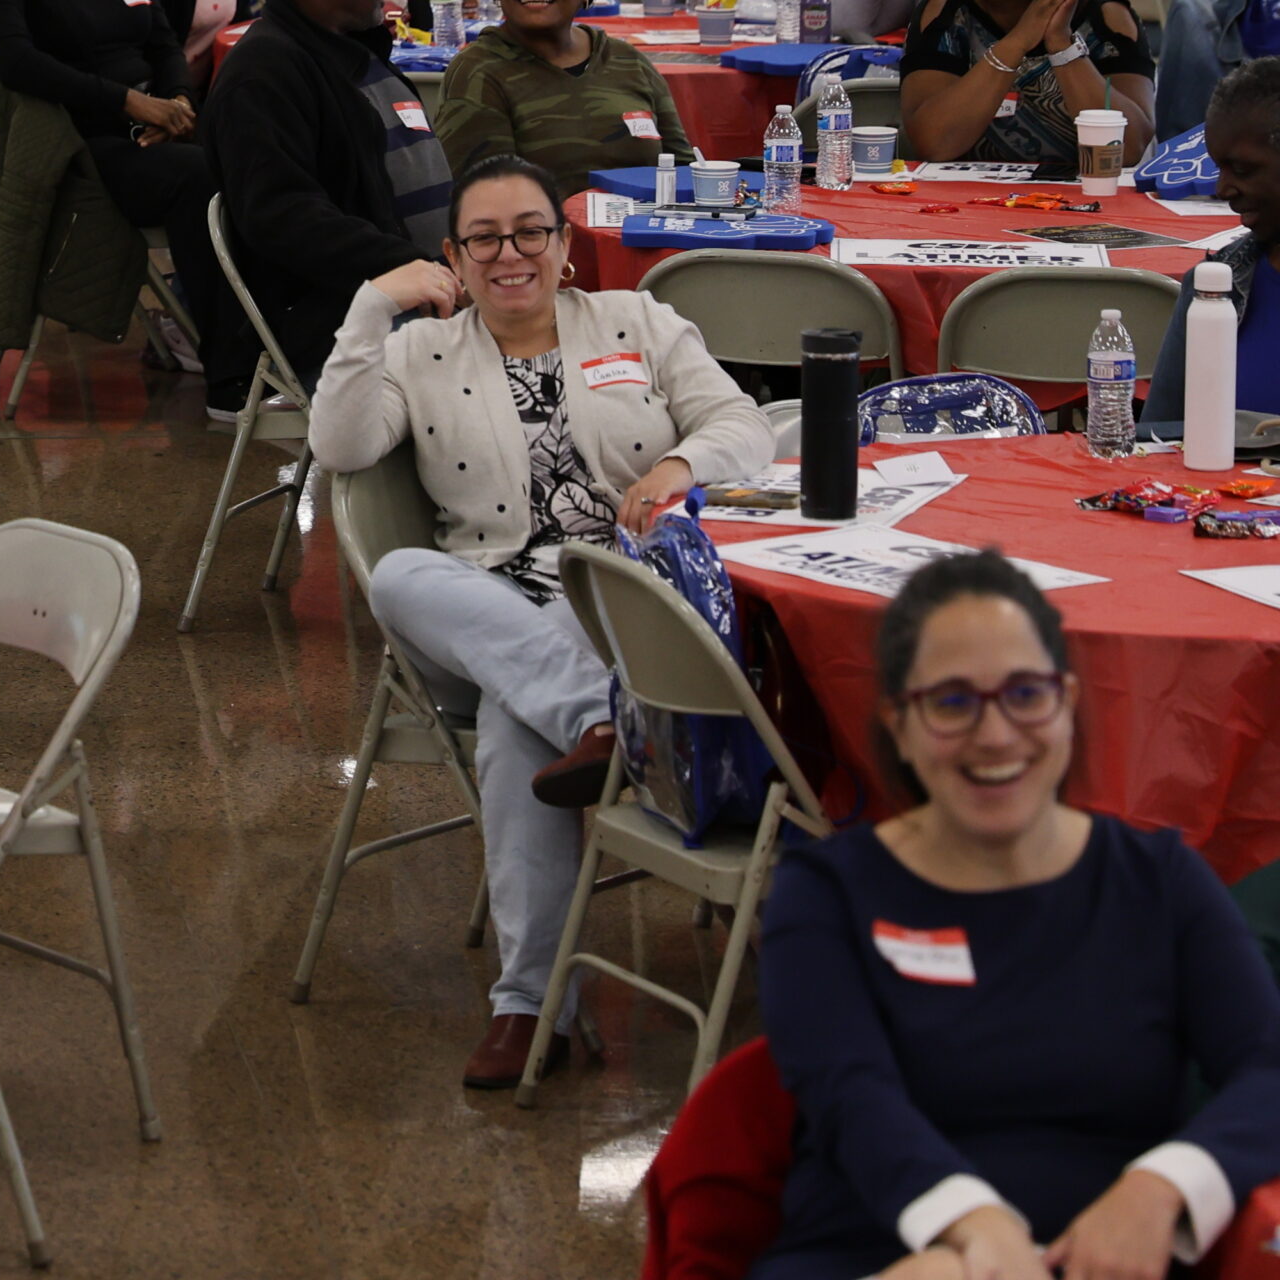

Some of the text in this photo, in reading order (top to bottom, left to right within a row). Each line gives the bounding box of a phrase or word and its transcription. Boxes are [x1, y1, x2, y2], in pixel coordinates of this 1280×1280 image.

[856, 252, 1085, 263] LATIMER
[908, 258, 1075, 267] CONGRESS
[766, 543, 911, 580] LATIM
